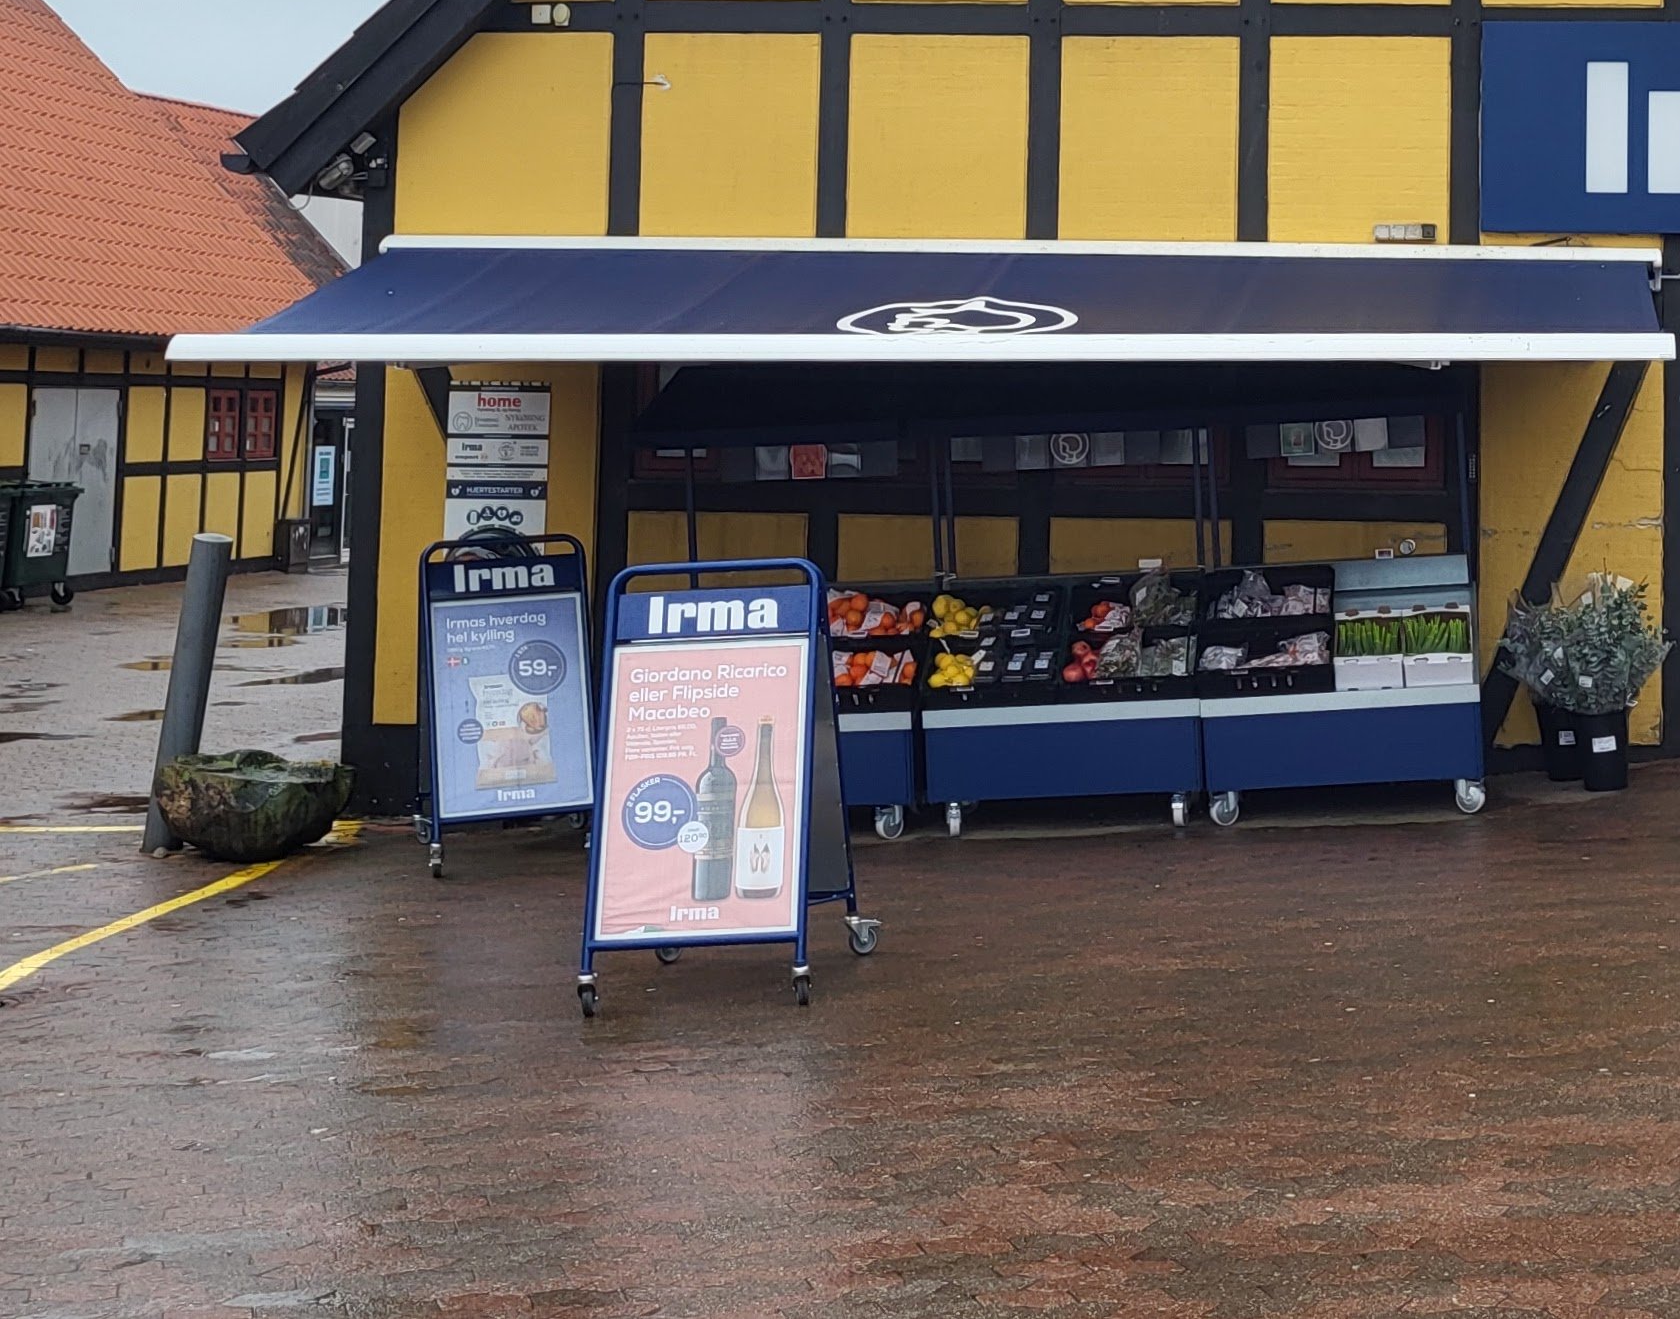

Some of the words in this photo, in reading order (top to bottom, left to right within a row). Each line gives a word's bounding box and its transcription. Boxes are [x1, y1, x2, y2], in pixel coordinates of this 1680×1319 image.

[477, 393, 522, 408] home
[466, 486, 523, 494] HJERTESTARTER
[453, 564, 555, 593] Irma
[446, 618, 486, 630] Irmas
[489, 612, 546, 626] hverdag
[648, 596, 778, 634] Irma
[446, 632, 477, 643] hel
[481, 628, 514, 644] kylling
[519, 659, 557, 676] 59,-
[630, 667, 712, 683] Giordano
[717, 663, 787, 680] Ricarico
[629, 688, 667, 703] eller
[672, 683, 739, 703] Flipside
[628, 705, 710, 722] Macabeo
[497, 788, 535, 801] Irma
[631, 777, 661, 801] FLASKER
[634, 800, 685, 824] 99,-
[670, 905, 720, 922] Irma
